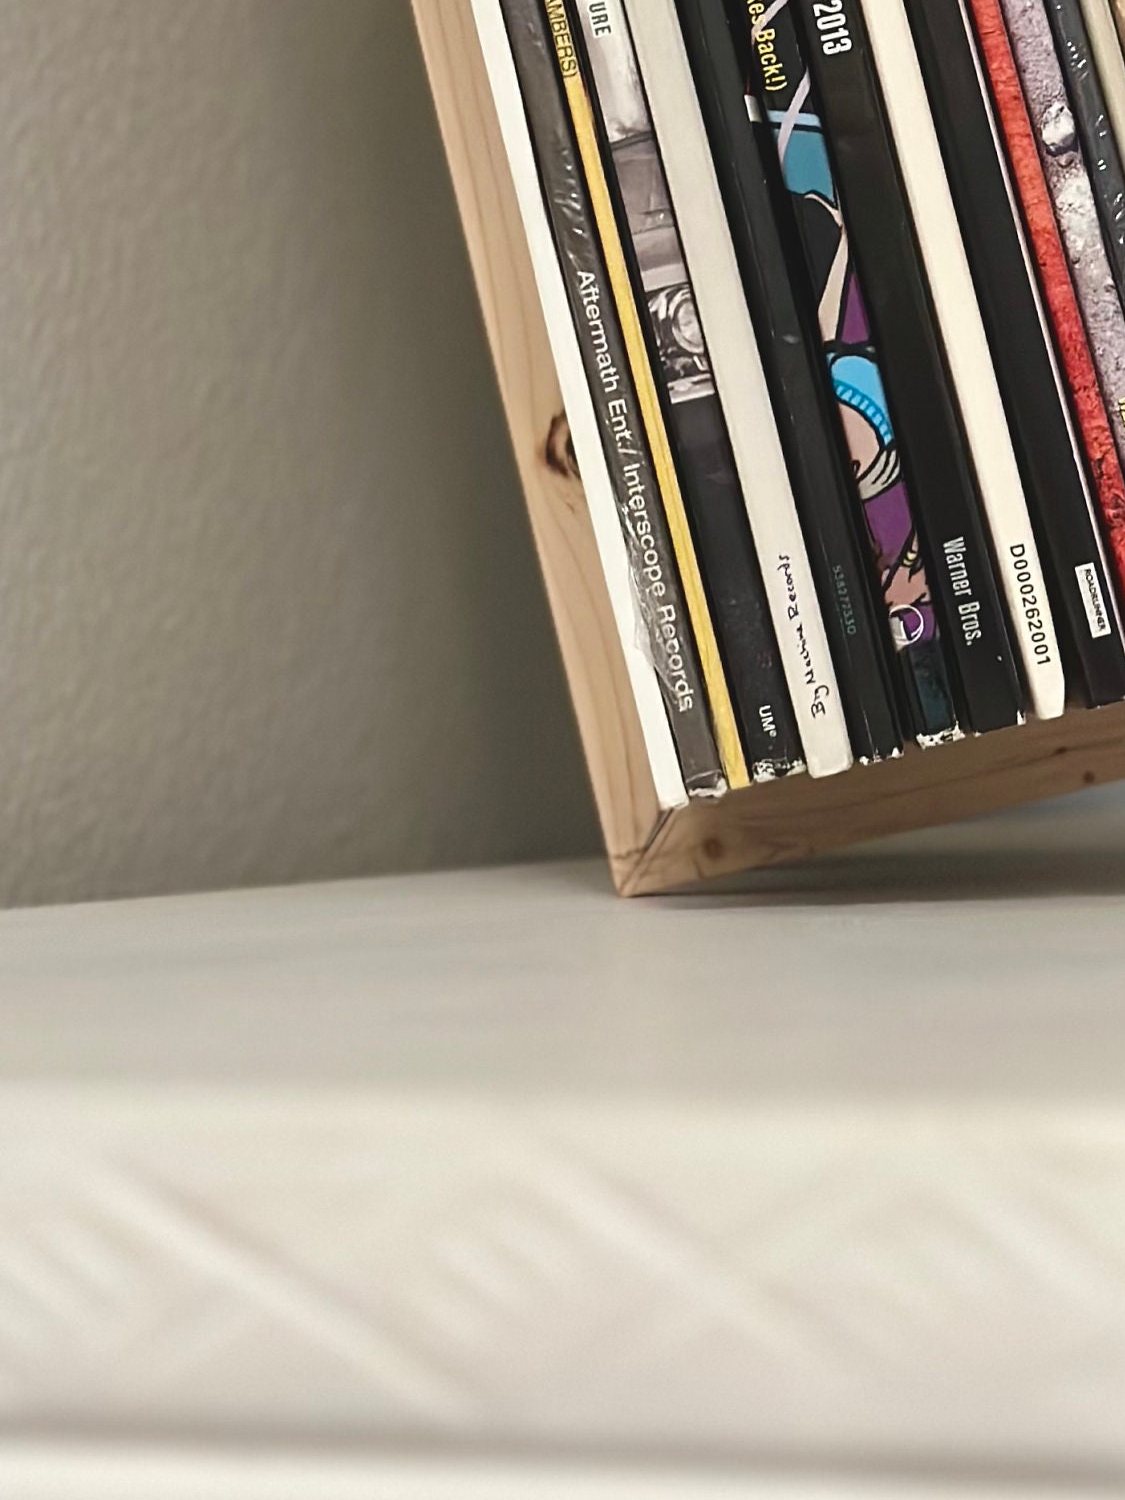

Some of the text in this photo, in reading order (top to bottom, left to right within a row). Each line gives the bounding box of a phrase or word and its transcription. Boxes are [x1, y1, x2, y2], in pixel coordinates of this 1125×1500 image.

[751, 28, 788, 93] Back!)
[576, 268, 622, 393] Aftermath
[617, 462, 670, 599] Interscope
[654, 603, 698, 712] Records
[773, 551, 804, 621] Records
[940, 536, 988, 646] Warner Bros.
[1007, 543, 1053, 666] D000262001
[1082, 567, 1106, 632] ROADRUNNER
